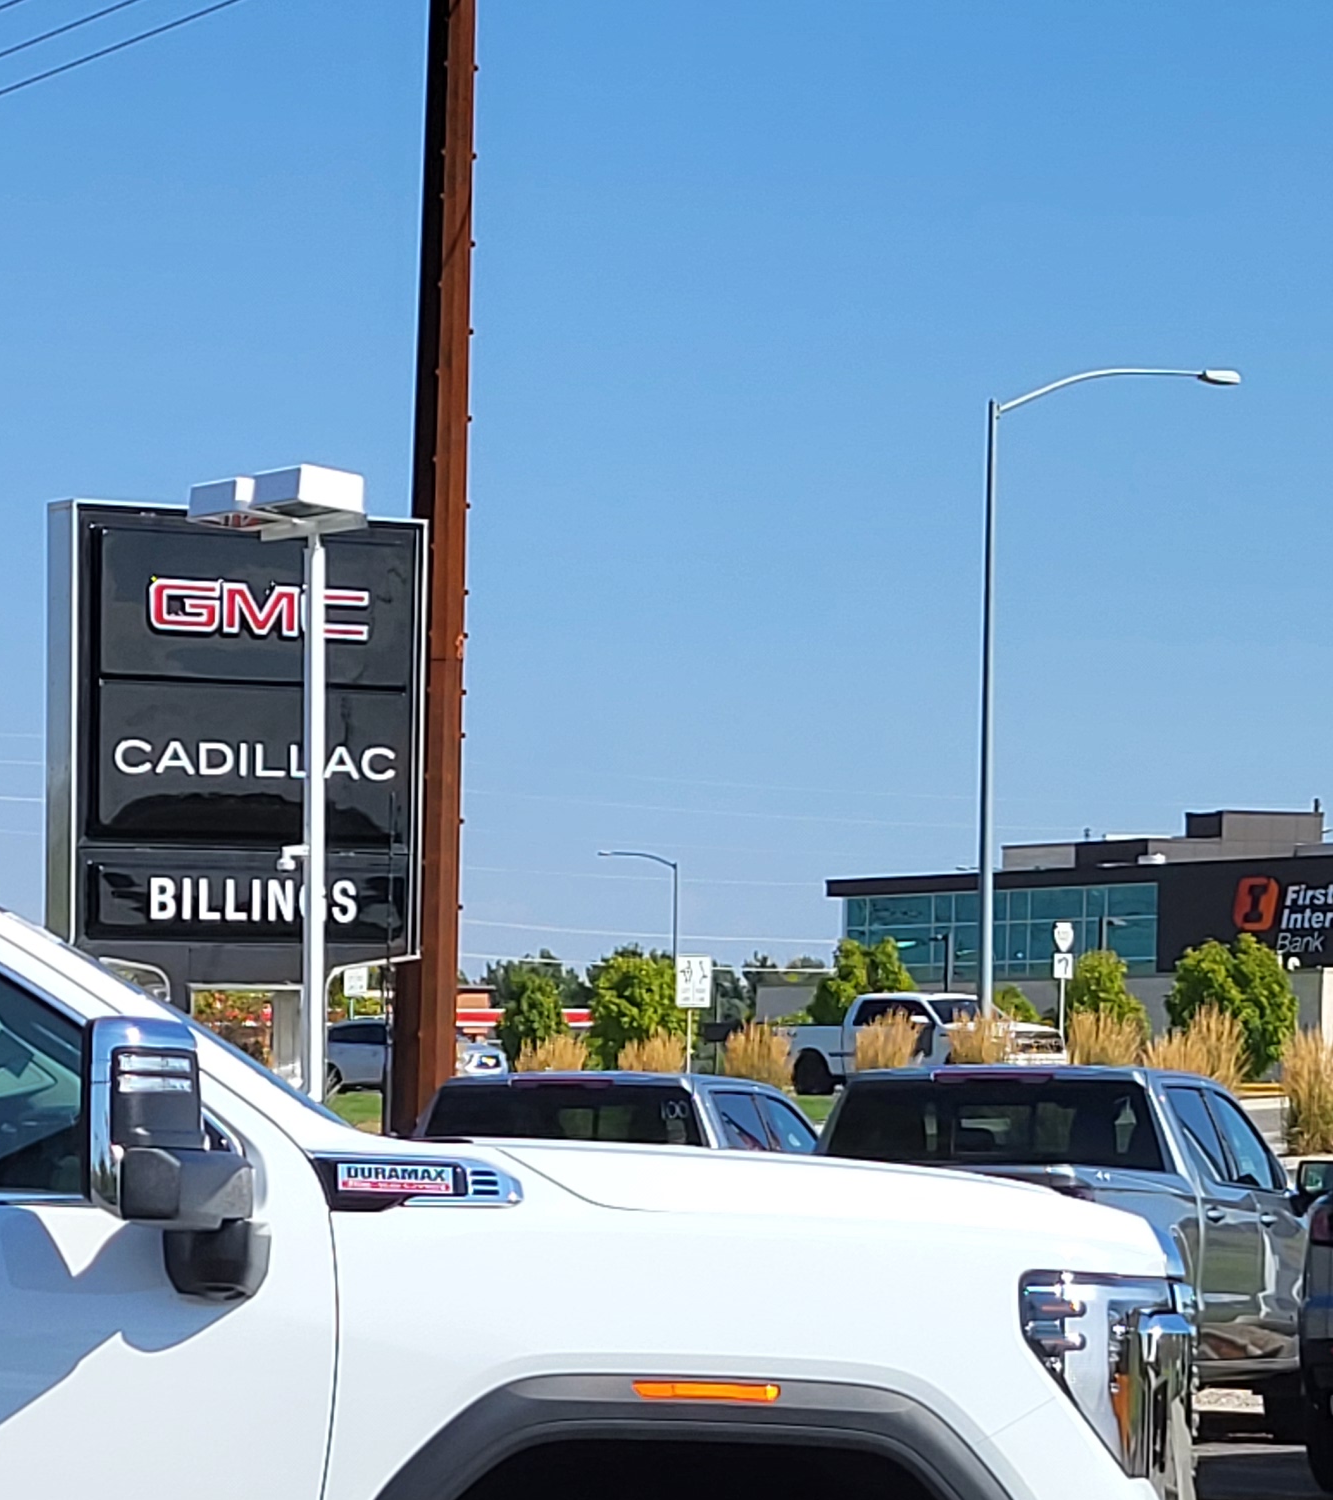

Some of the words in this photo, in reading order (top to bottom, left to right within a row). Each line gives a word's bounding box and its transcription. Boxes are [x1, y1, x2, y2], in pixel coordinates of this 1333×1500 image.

[149, 578, 369, 641] GMC
[114, 739, 396, 781] CADILLAC
[1285, 884, 1333, 906] First
[1277, 932, 1325, 953] Bank
[347, 1166, 445, 1182] DURAMAX
